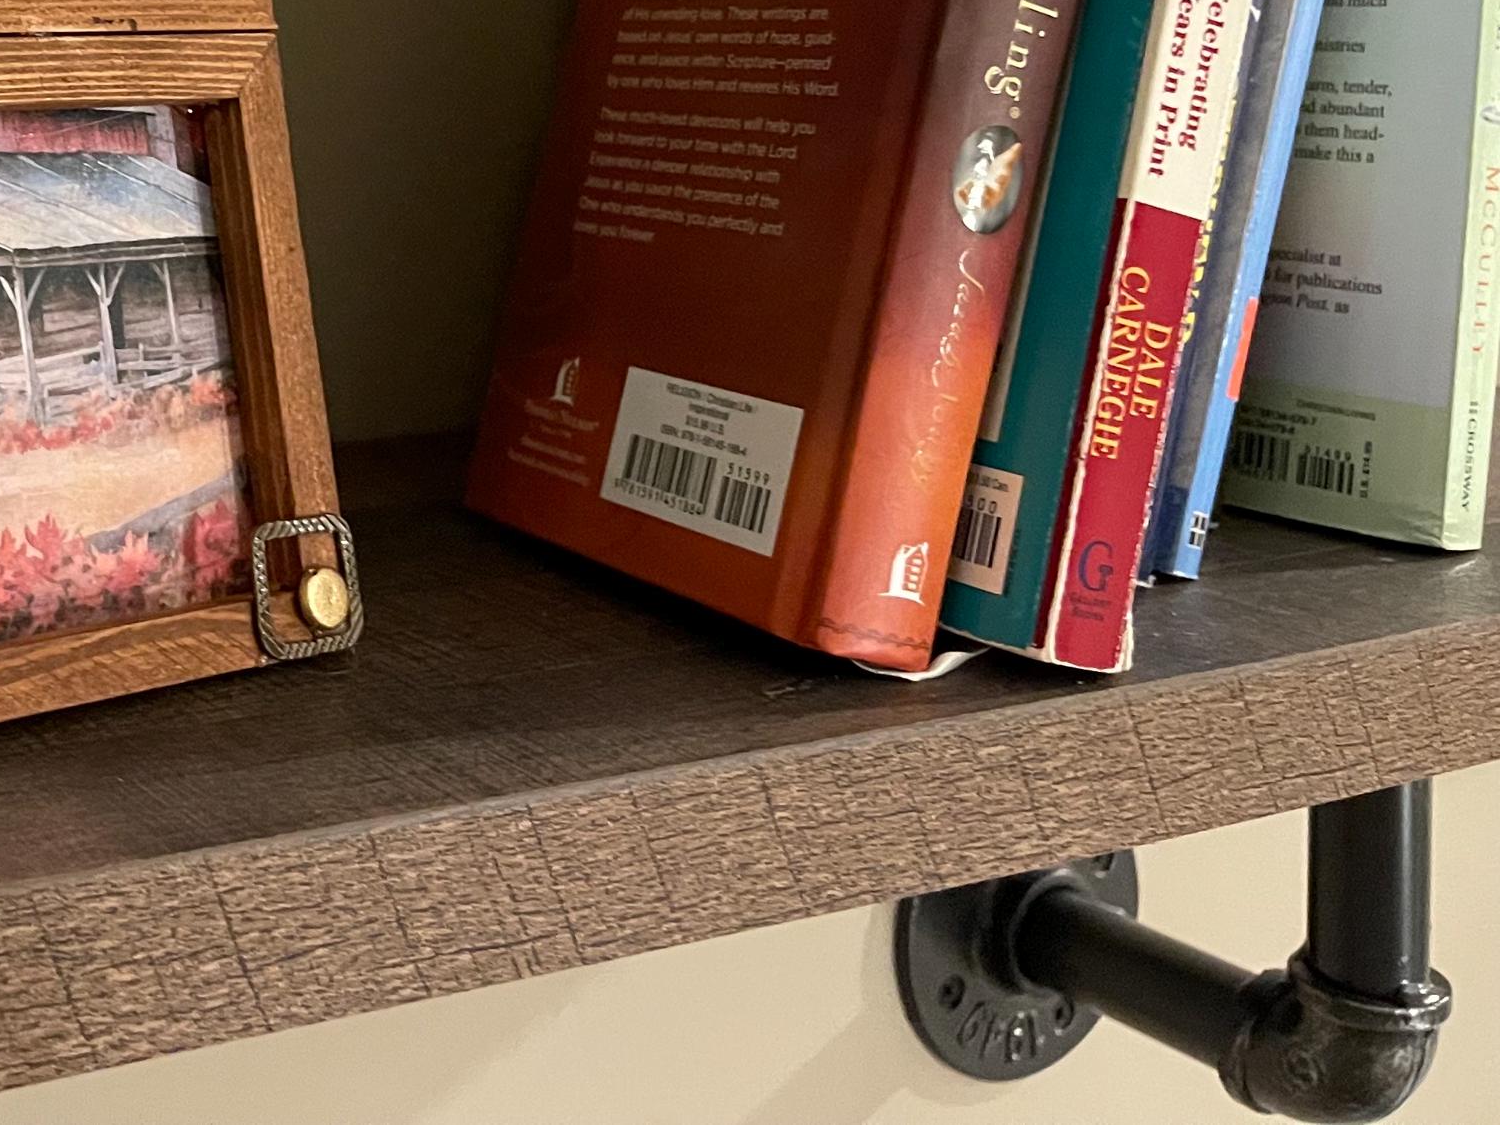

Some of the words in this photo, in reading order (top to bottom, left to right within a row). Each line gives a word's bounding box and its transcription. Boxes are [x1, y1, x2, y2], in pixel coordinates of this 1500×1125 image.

[1159, 61, 1181, 92] in
[1343, 79, 1393, 97] tender,
[1319, 101, 1385, 118] abundant
[1147, 97, 1177, 178] Print
[1304, 122, 1339, 138] them
[1342, 124, 1386, 141] head-
[1335, 146, 1362, 163] this
[1295, 272, 1383, 295] publications
[1090, 264, 1151, 461] CARNEGIE
[1128, 321, 1173, 420] DALE
[1458, 411, 1479, 513] CROSSWAY
[1077, 540, 1114, 592] G
